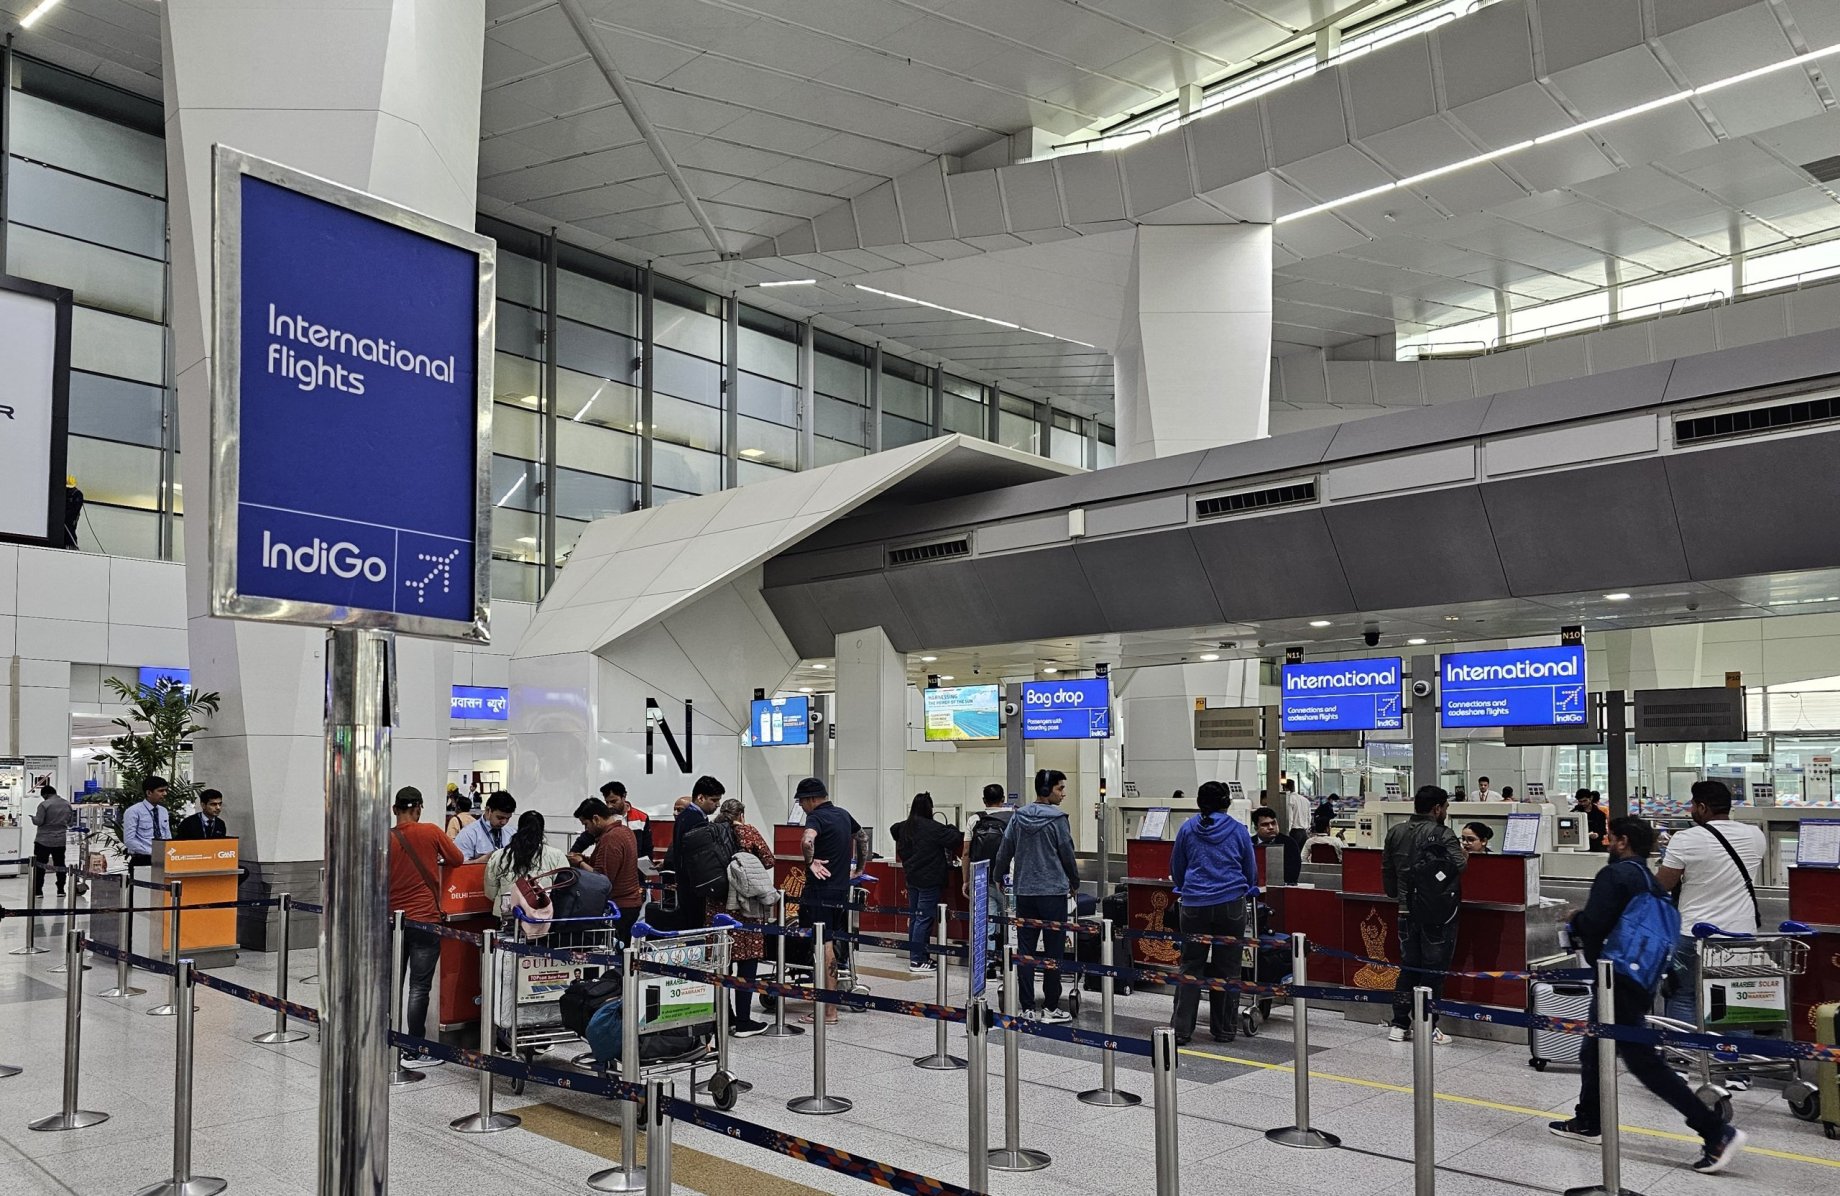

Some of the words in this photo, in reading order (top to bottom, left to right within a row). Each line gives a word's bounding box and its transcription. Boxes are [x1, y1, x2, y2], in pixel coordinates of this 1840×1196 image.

[268, 303, 455, 384] International
[268, 343, 366, 395] flights
[262, 530, 387, 583] IndiGo
[1562, 631, 1582, 639] N10
[1447, 655, 1578, 682] International
[1287, 666, 1396, 691] International
[1027, 689, 1052, 708] Bag
[1053, 687, 1084, 707] drop
[1287, 706, 1324, 714] Connections
[1324, 704, 1338, 712] and
[1448, 700, 1491, 709] Connections
[1491, 698, 1507, 707] and
[1287, 714, 1319, 722] codeshare
[1319, 712, 1339, 722] flights
[1448, 708, 1485, 717] codeshare
[1486, 706, 1510, 717] flights
[1377, 719, 1399, 727] IndiGo
[1556, 714, 1583, 722] IndiGo
[646, 697, 693, 774] N
[451, 892, 469, 900] DELHI
[670, 988, 681, 998] 30
[1736, 991, 1748, 1000] 30
